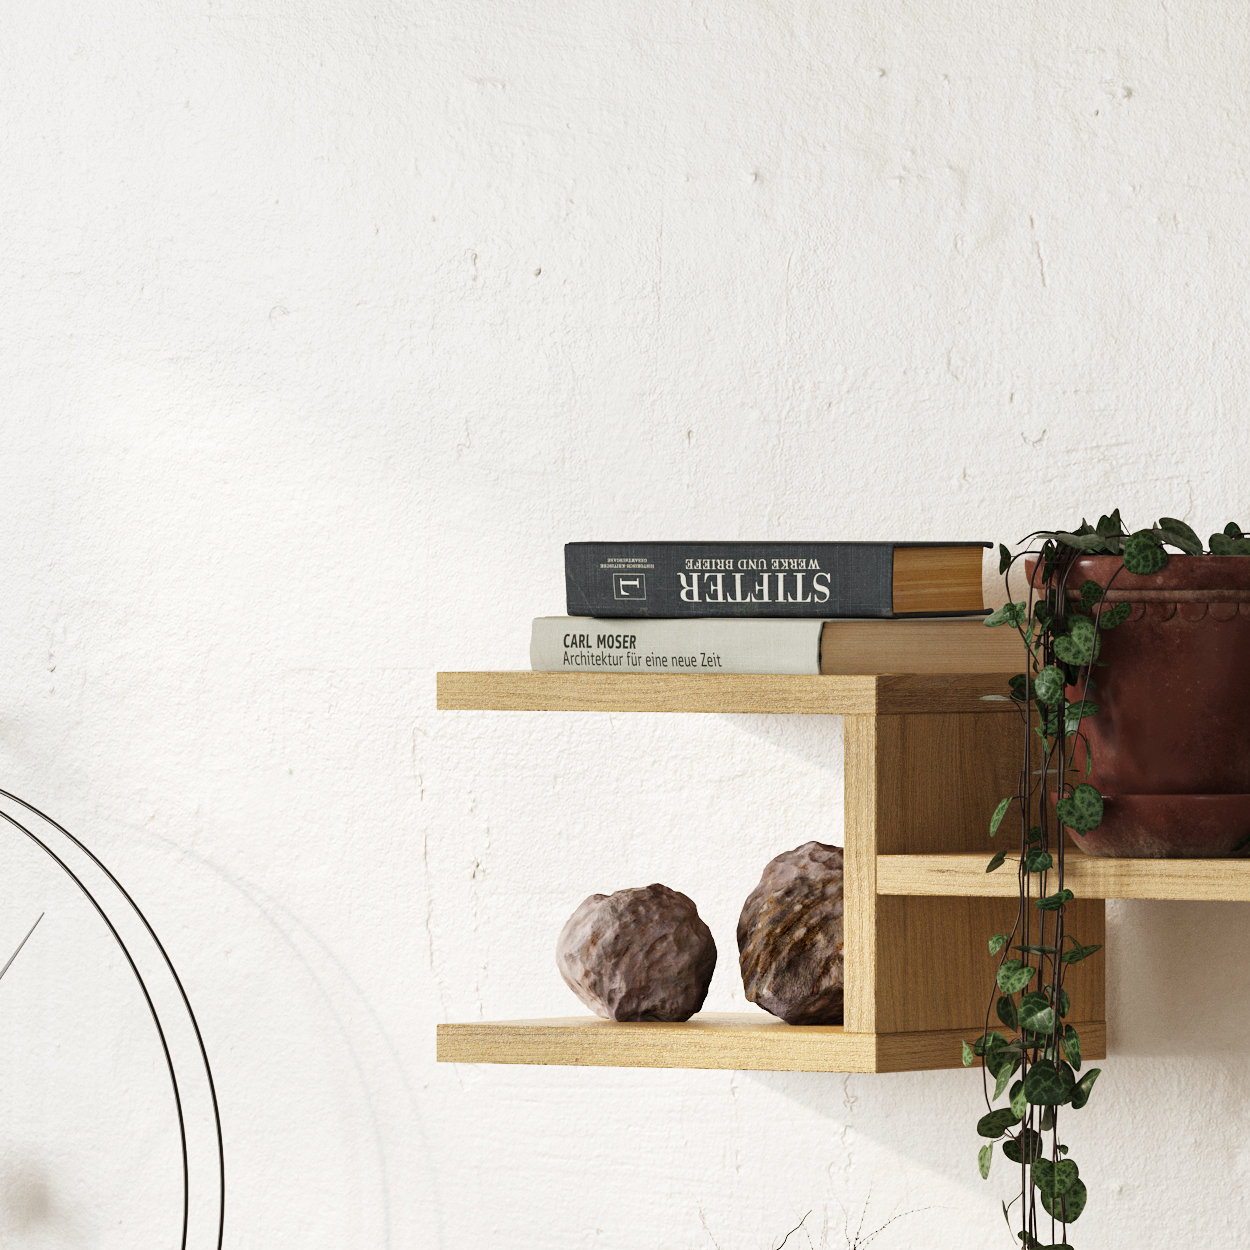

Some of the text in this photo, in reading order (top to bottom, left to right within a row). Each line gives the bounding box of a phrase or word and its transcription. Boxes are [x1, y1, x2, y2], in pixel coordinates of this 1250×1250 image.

[685, 559, 820, 570] WERKE UND BRIEFE
[677, 572, 831, 603] STIFTER
[563, 634, 637, 650] CARL MOSER
[563, 651, 722, 668] Architektur für eine neue Zeit
